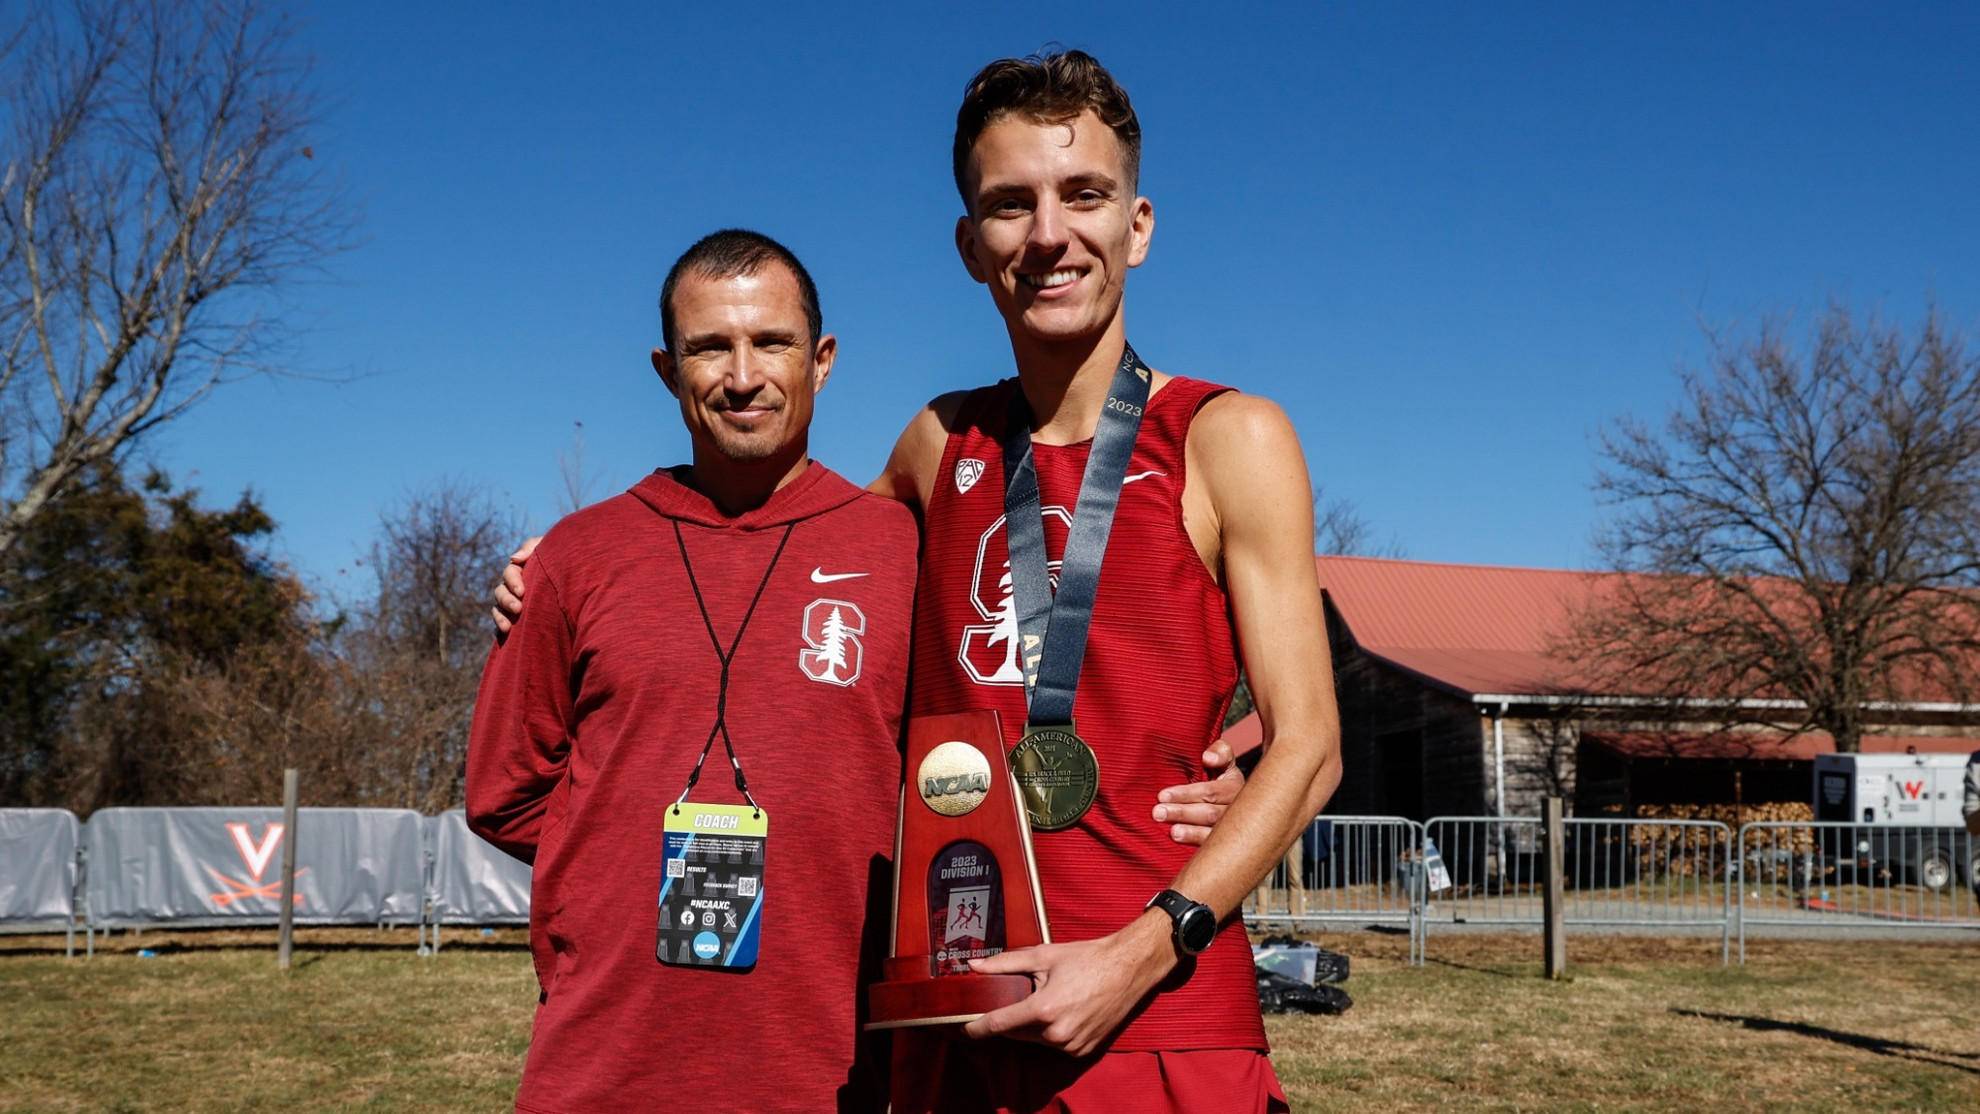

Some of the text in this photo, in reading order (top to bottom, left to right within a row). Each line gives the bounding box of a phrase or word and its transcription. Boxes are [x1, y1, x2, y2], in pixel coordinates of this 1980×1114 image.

[1108, 397, 1142, 417] 2023
[956, 460, 984, 480] PAC
[958, 474, 974, 487] 12
[925, 773, 988, 798] NCAA
[694, 813, 739, 829] COACH
[224, 822, 285, 882] V
[951, 855, 977, 868] 2023
[941, 864, 990, 880] DIVISION I
[690, 899, 731, 910] #NCAAXC
[948, 950, 971, 960] CROSS
[972, 947, 1004, 958] COUNTRY
